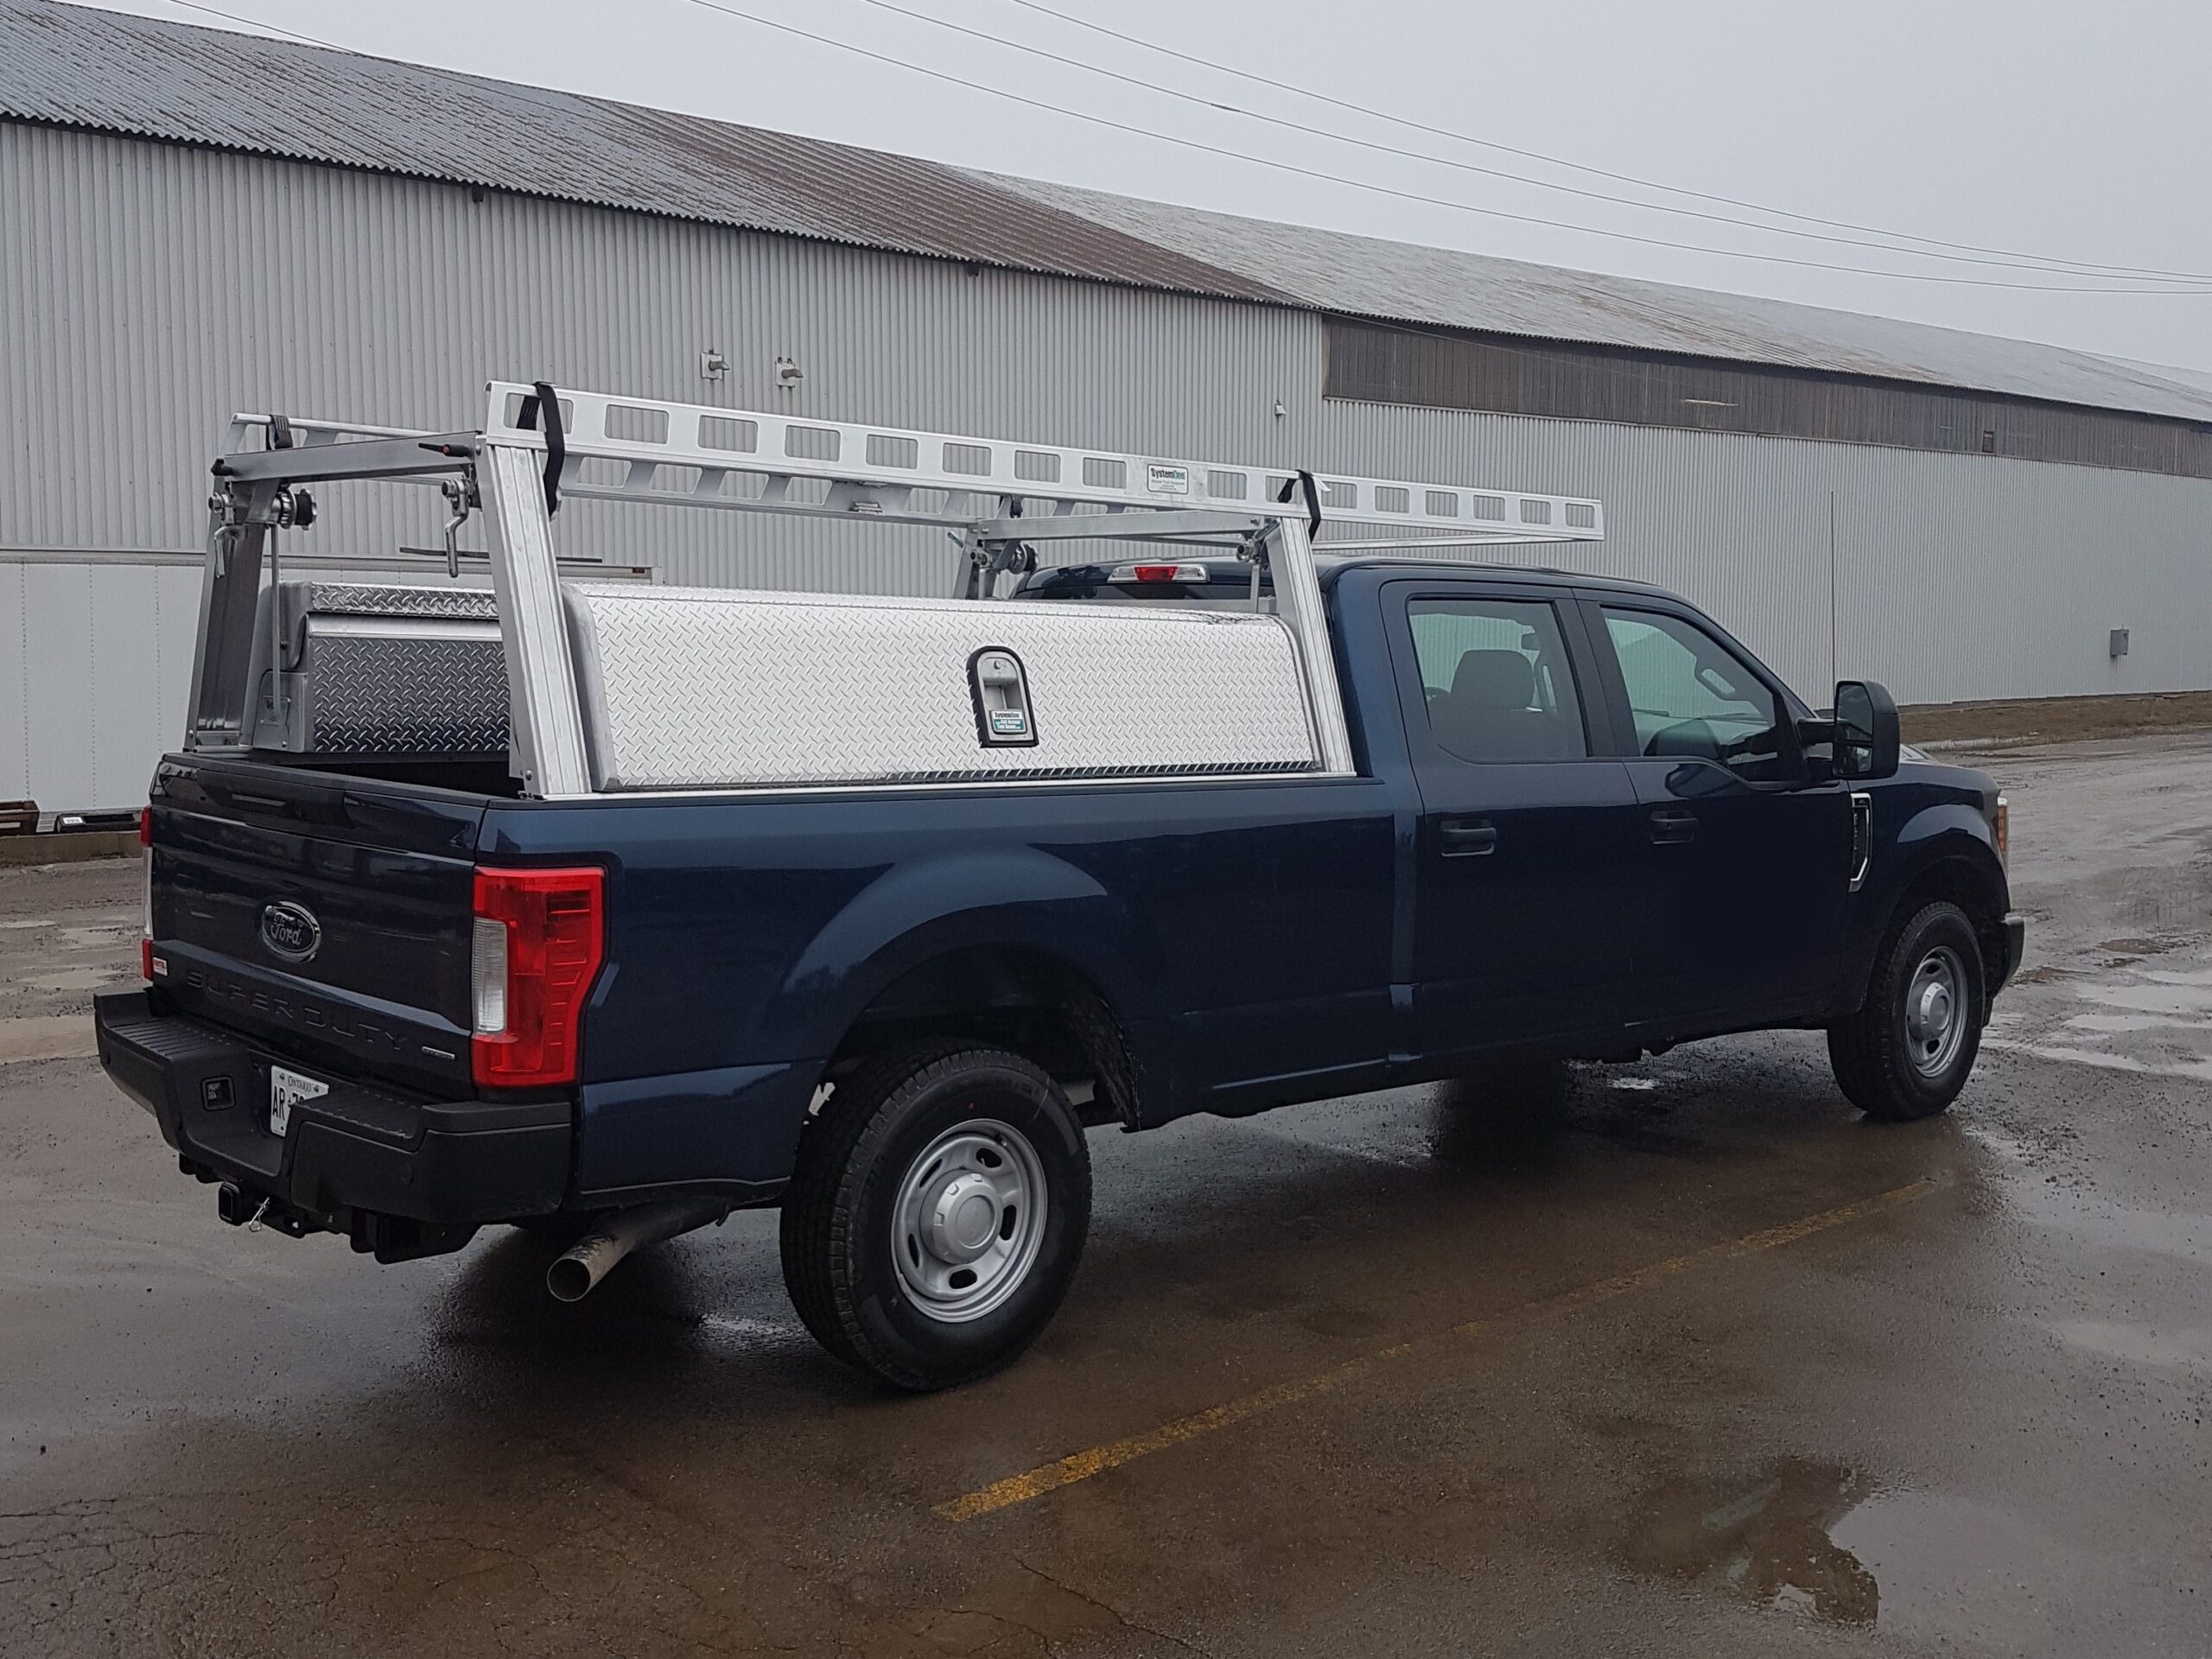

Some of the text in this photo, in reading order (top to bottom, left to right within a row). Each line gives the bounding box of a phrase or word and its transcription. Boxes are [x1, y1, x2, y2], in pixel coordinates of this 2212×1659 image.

[270, 922, 302, 945] Ford
[187, 969, 409, 1051] SUPER DUTY
